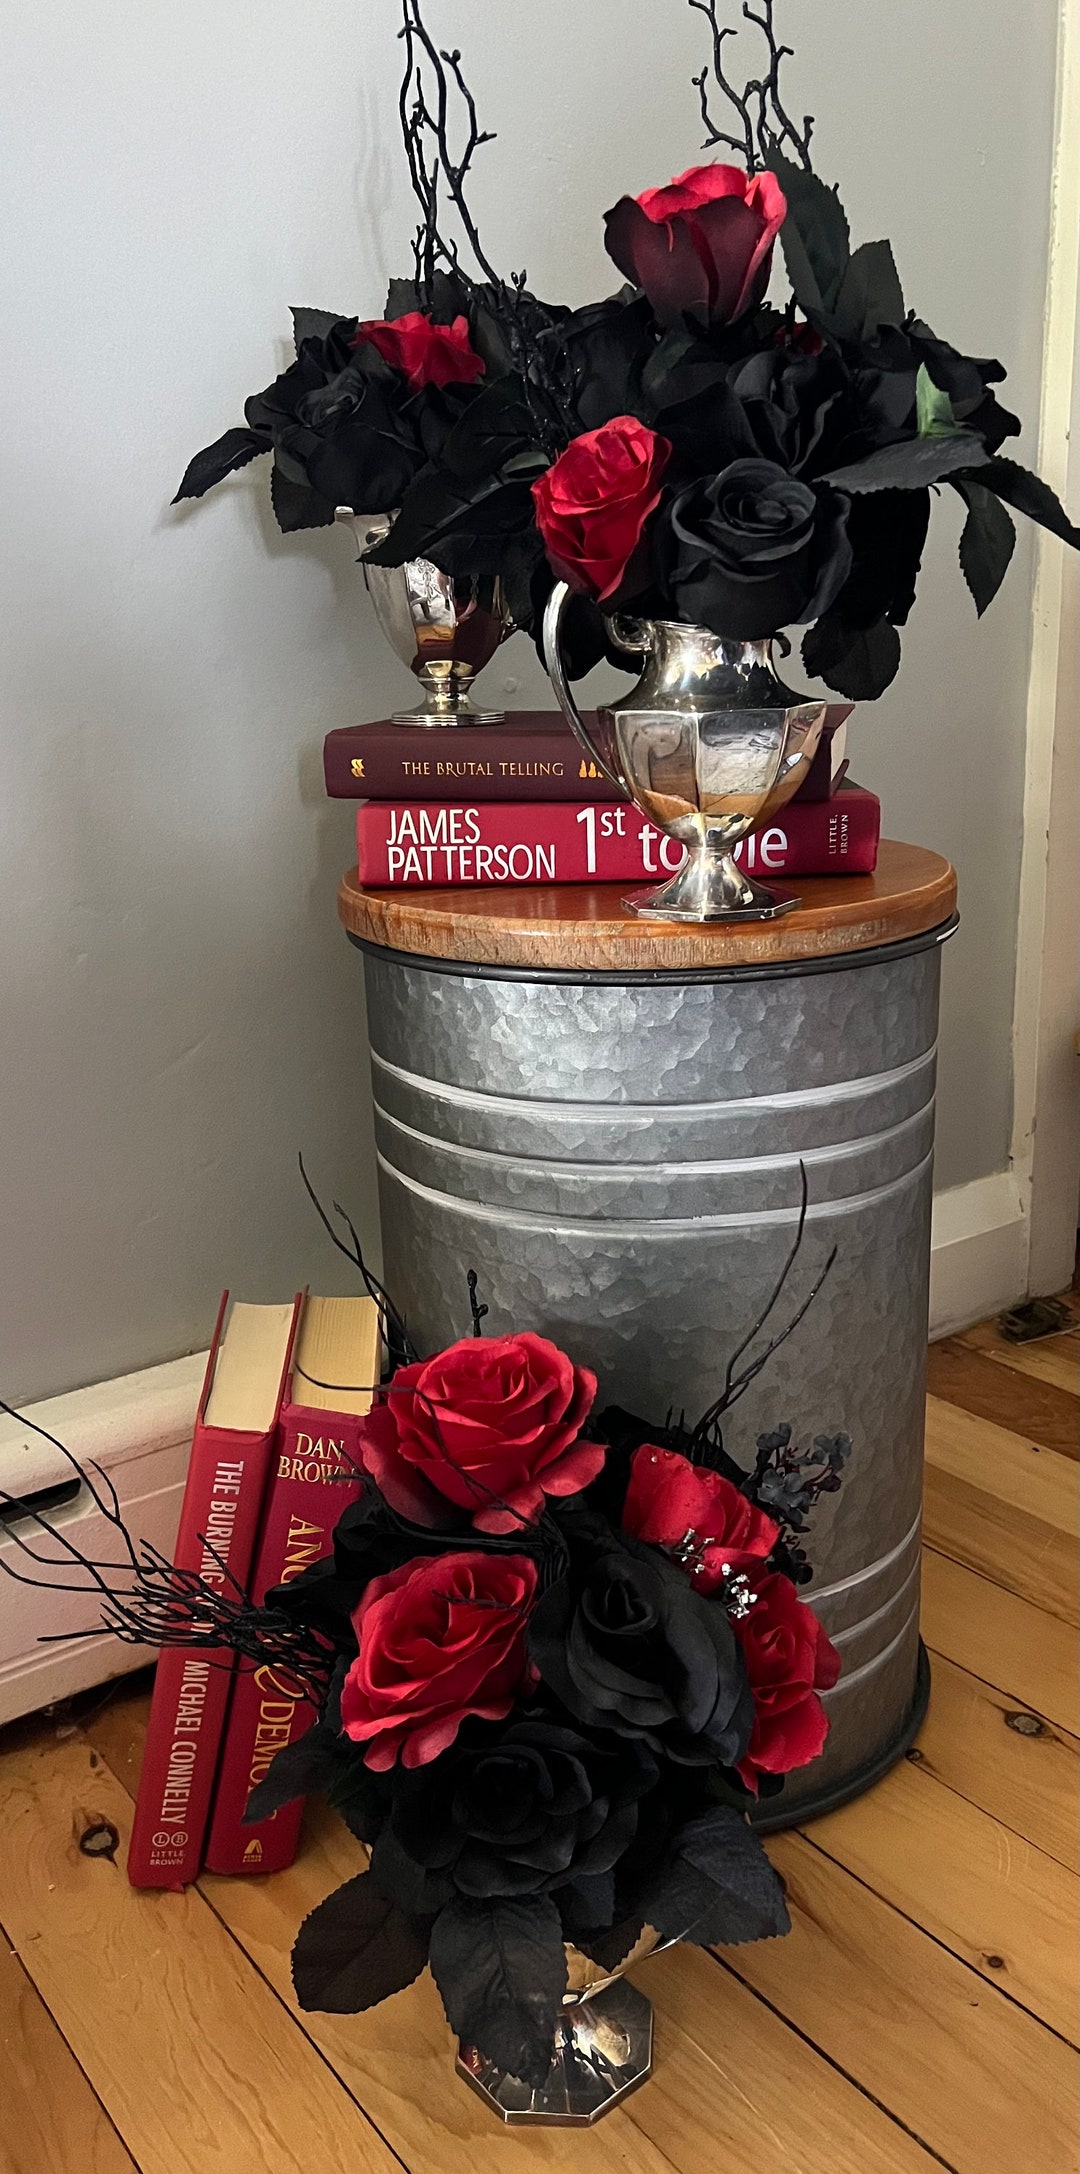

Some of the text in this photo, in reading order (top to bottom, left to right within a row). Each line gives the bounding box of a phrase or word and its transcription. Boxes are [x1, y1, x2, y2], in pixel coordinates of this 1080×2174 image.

[402, 761, 564, 777] THE BRUTAL TELLING
[386, 808, 481, 845] JAMES
[576, 806, 788, 873] 1st to ie
[840, 814, 849, 854] BROWN
[388, 844, 556, 881] PATTERSON
[294, 1432, 345, 1461] DAN
[213, 1460, 244, 1495] THE
[200, 1500, 237, 1584] BURNING
[174, 1660, 210, 1735] MICHAEL
[160, 1741, 197, 1824] CONNELLY
[149, 1858, 184, 1866] BROWN
